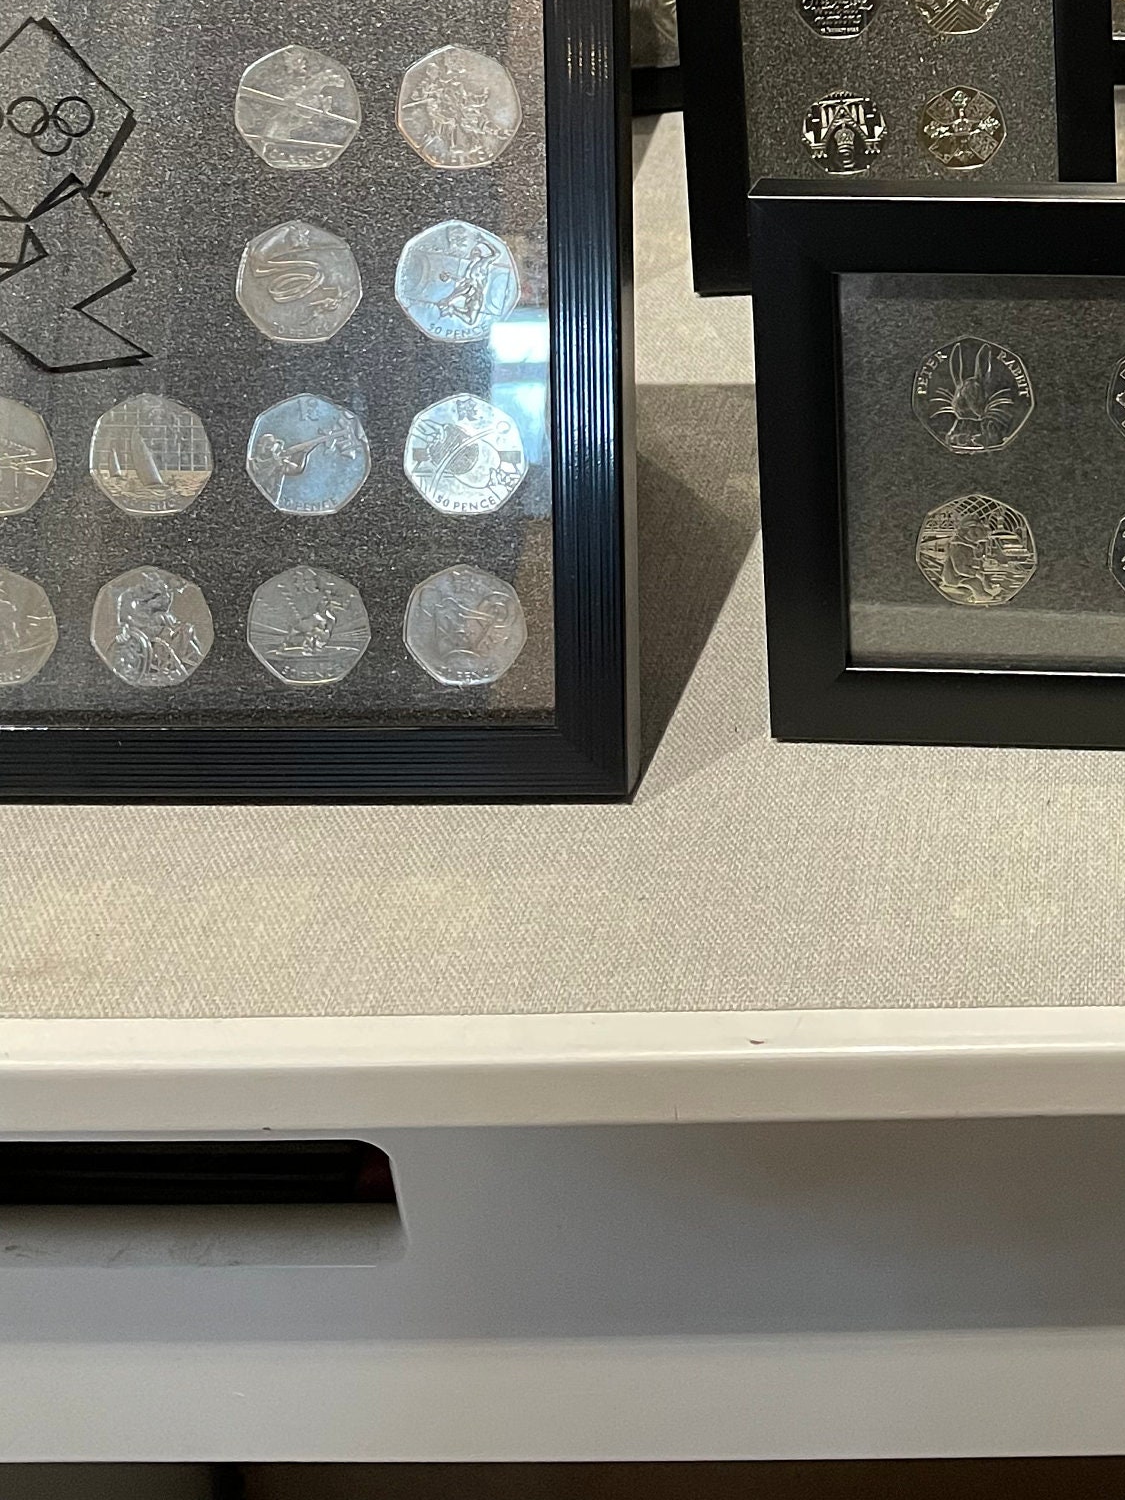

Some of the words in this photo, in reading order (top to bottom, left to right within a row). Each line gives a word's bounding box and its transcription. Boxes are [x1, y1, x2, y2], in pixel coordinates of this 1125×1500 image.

[444, 323, 488, 338] PENCE
[917, 350, 948, 395] PETER
[996, 350, 1030, 398] RABBIT
[434, 494, 450, 507] 50
[452, 494, 496, 510] PENCE
